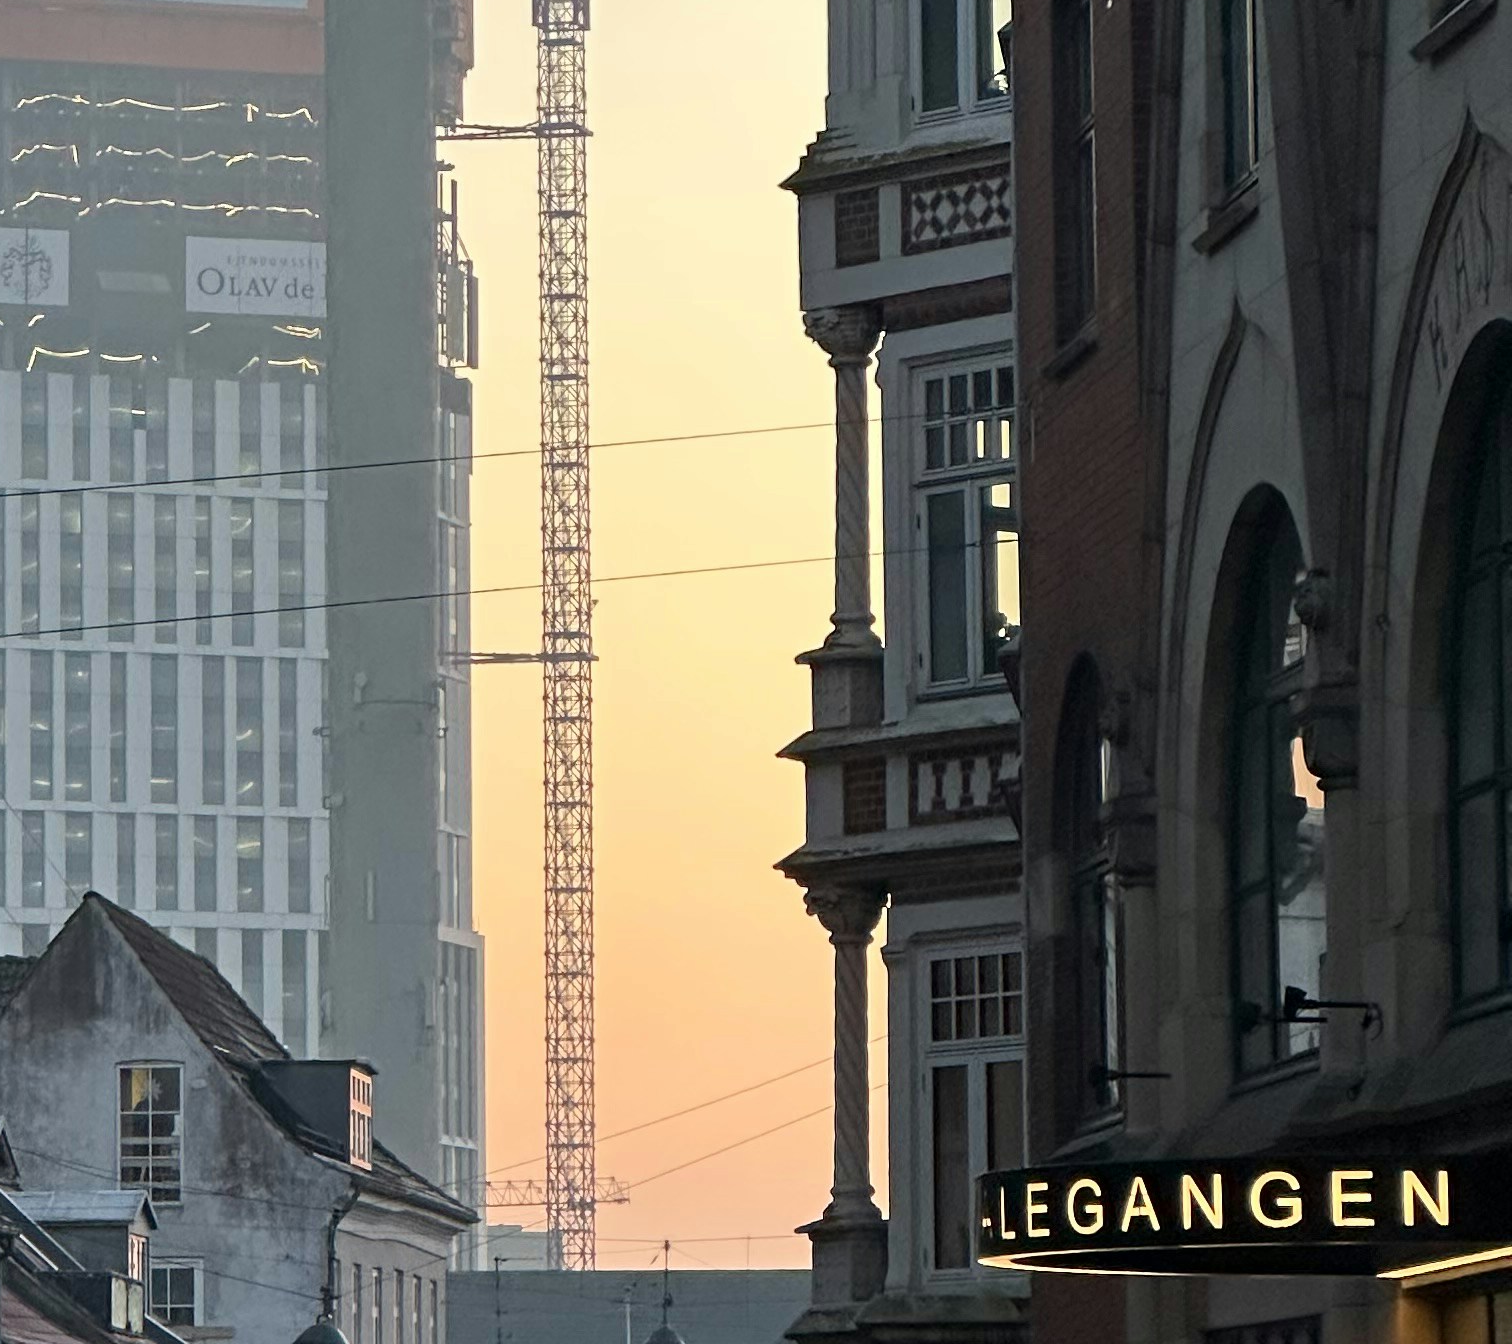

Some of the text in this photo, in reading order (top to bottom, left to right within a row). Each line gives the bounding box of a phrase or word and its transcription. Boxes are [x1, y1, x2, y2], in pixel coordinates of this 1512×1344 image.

[197, 267, 278, 298] OLAV
[284, 277, 315, 299] de
[982, 1170, 1450, 1240] LEGANGEN
